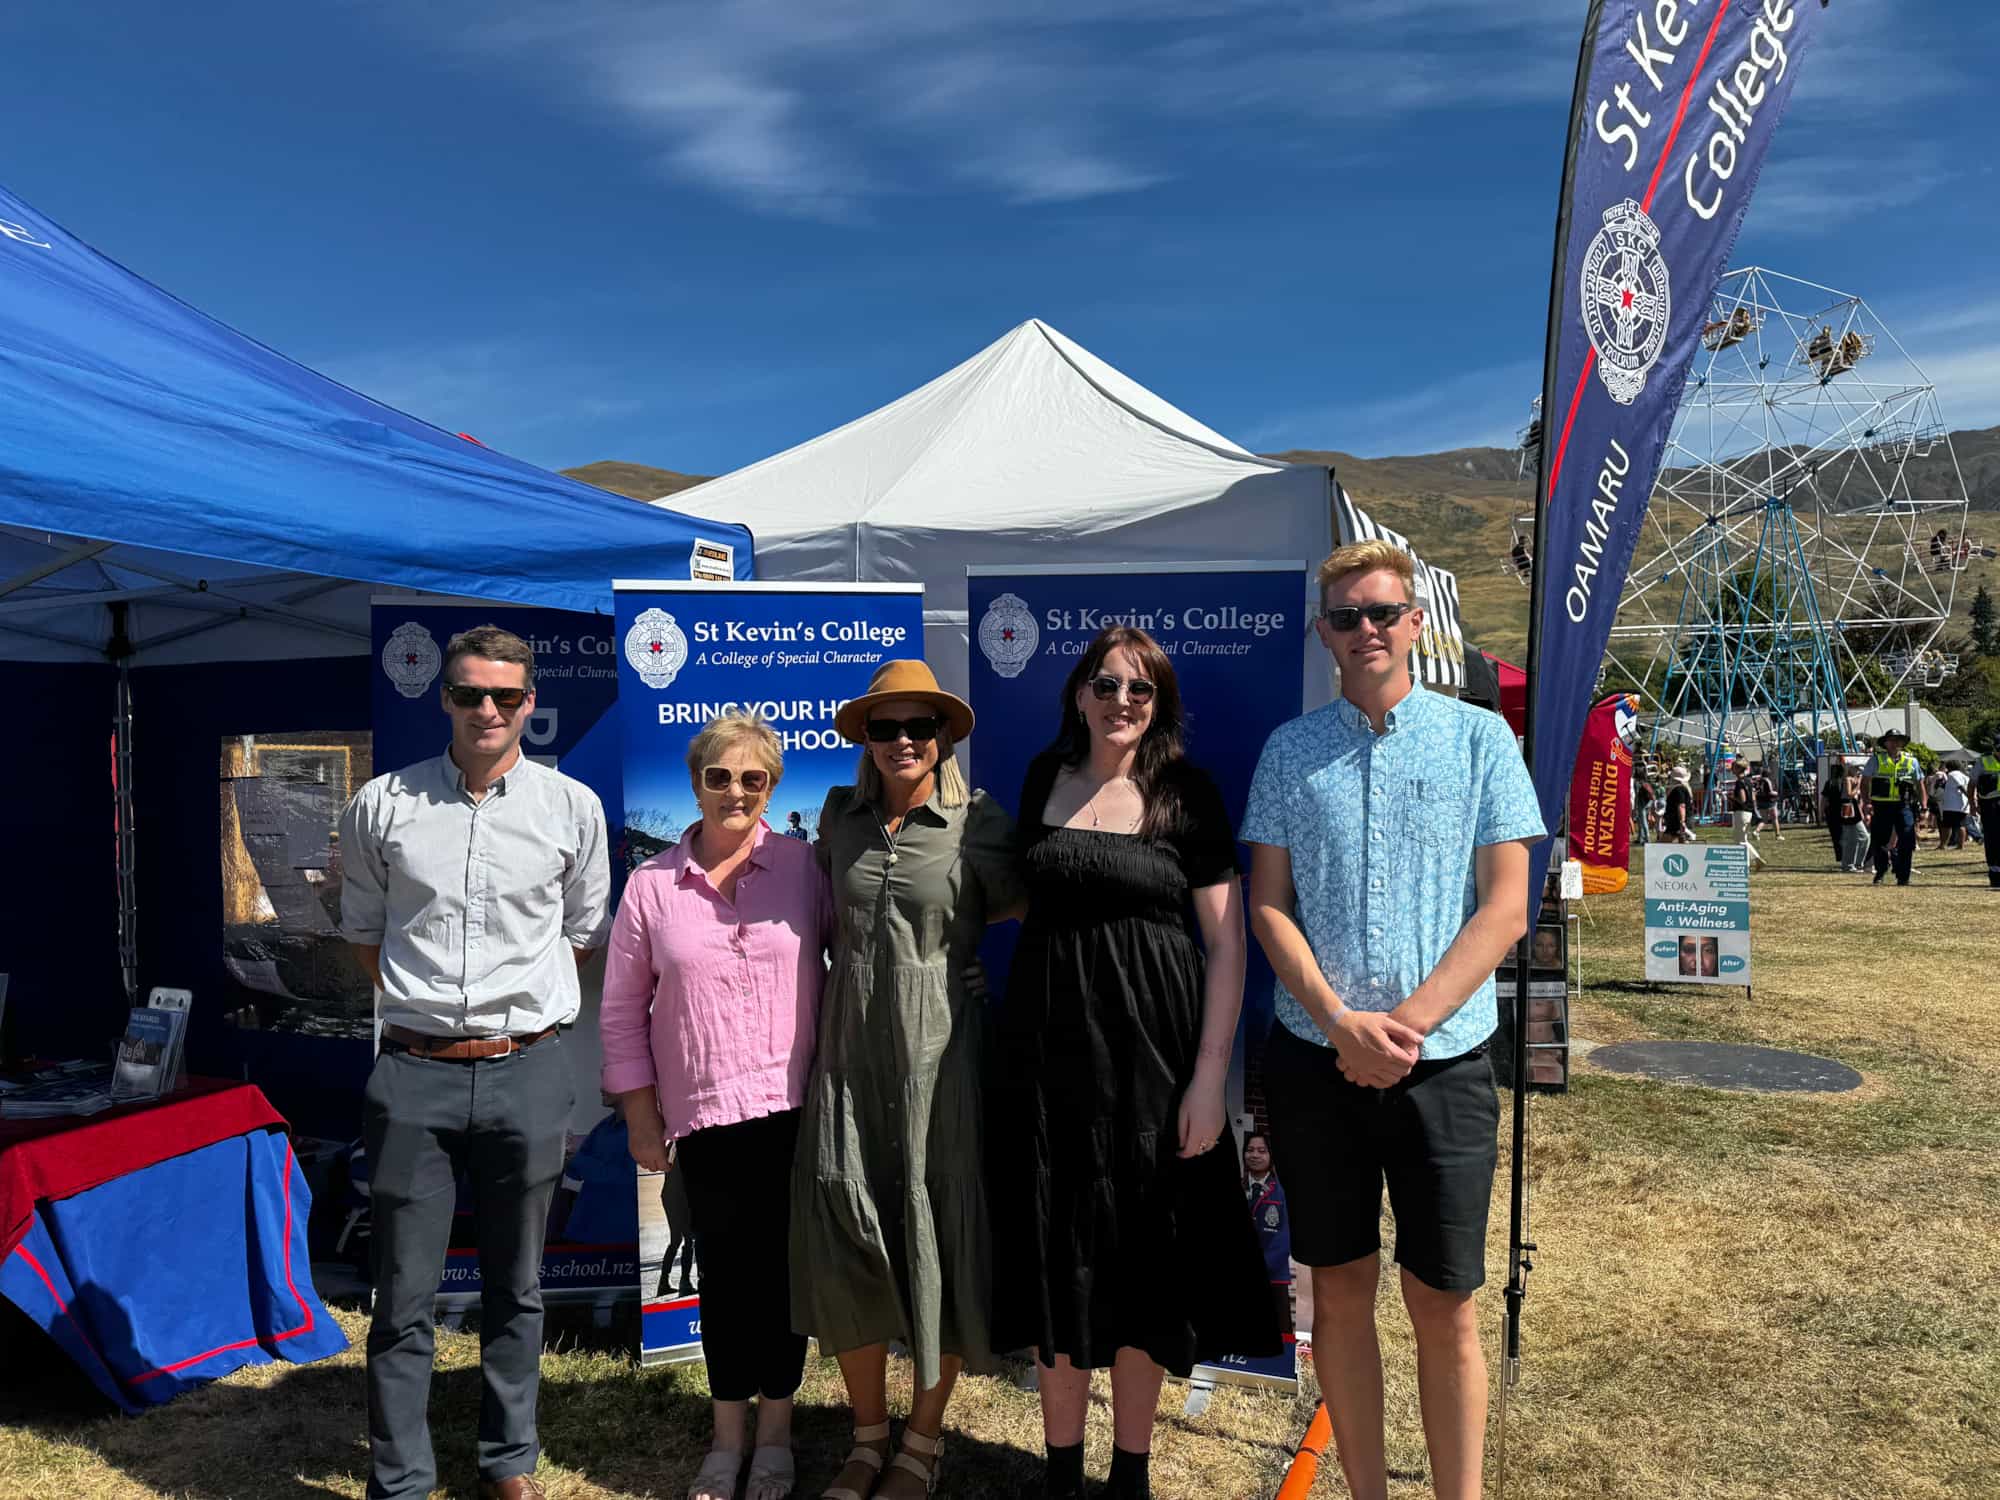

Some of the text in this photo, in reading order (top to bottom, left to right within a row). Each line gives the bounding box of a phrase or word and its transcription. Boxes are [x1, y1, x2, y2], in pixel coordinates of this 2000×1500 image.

[1685, 0, 1794, 219] College
[1595, 82, 1652, 171] St
[1616, 231, 1647, 254] SKC
[1566, 438, 1630, 622] OAMARU
[1046, 605, 1285, 636] St Kevin's College
[694, 620, 907, 647] St Kevin's College
[696, 650, 882, 668] A College of Special Character
[1045, 641, 1057, 655] A
[1061, 641, 1089, 655] Coll
[1182, 640, 1252, 655] Character
[744, 700, 814, 722] YOUR
[1584, 761, 1604, 854] HIGH SCHOOL
[1598, 763, 1618, 857] DUNSTAN
[1654, 881, 1698, 891] NEORA
[1656, 901, 1728, 916] Anti-Aging
[1664, 915, 1736, 929] & Wellness
